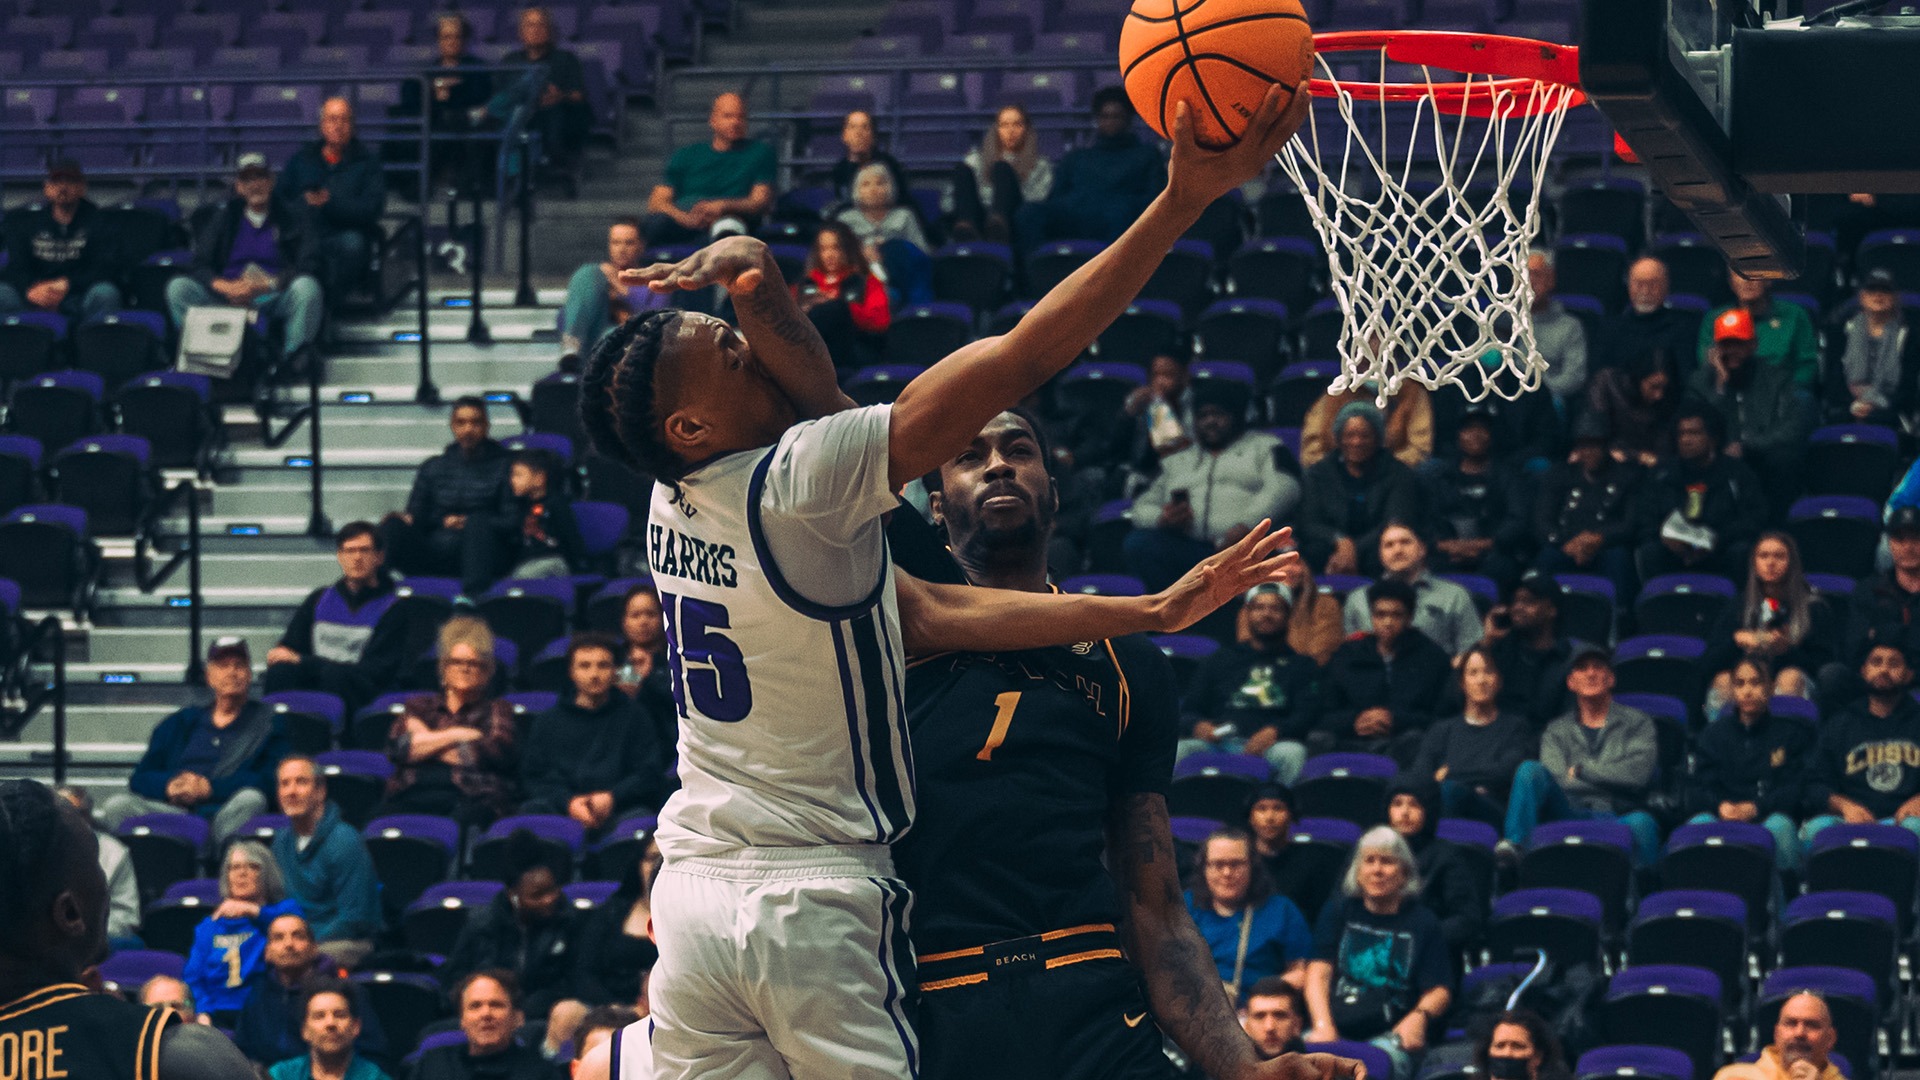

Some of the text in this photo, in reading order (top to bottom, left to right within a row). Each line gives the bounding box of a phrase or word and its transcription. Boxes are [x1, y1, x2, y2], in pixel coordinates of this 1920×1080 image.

[1231, 102, 1252, 118] NXT
[650, 523, 738, 588] HARRIS
[976, 691, 1023, 761] 1
[995, 953, 1036, 966] BEACH
